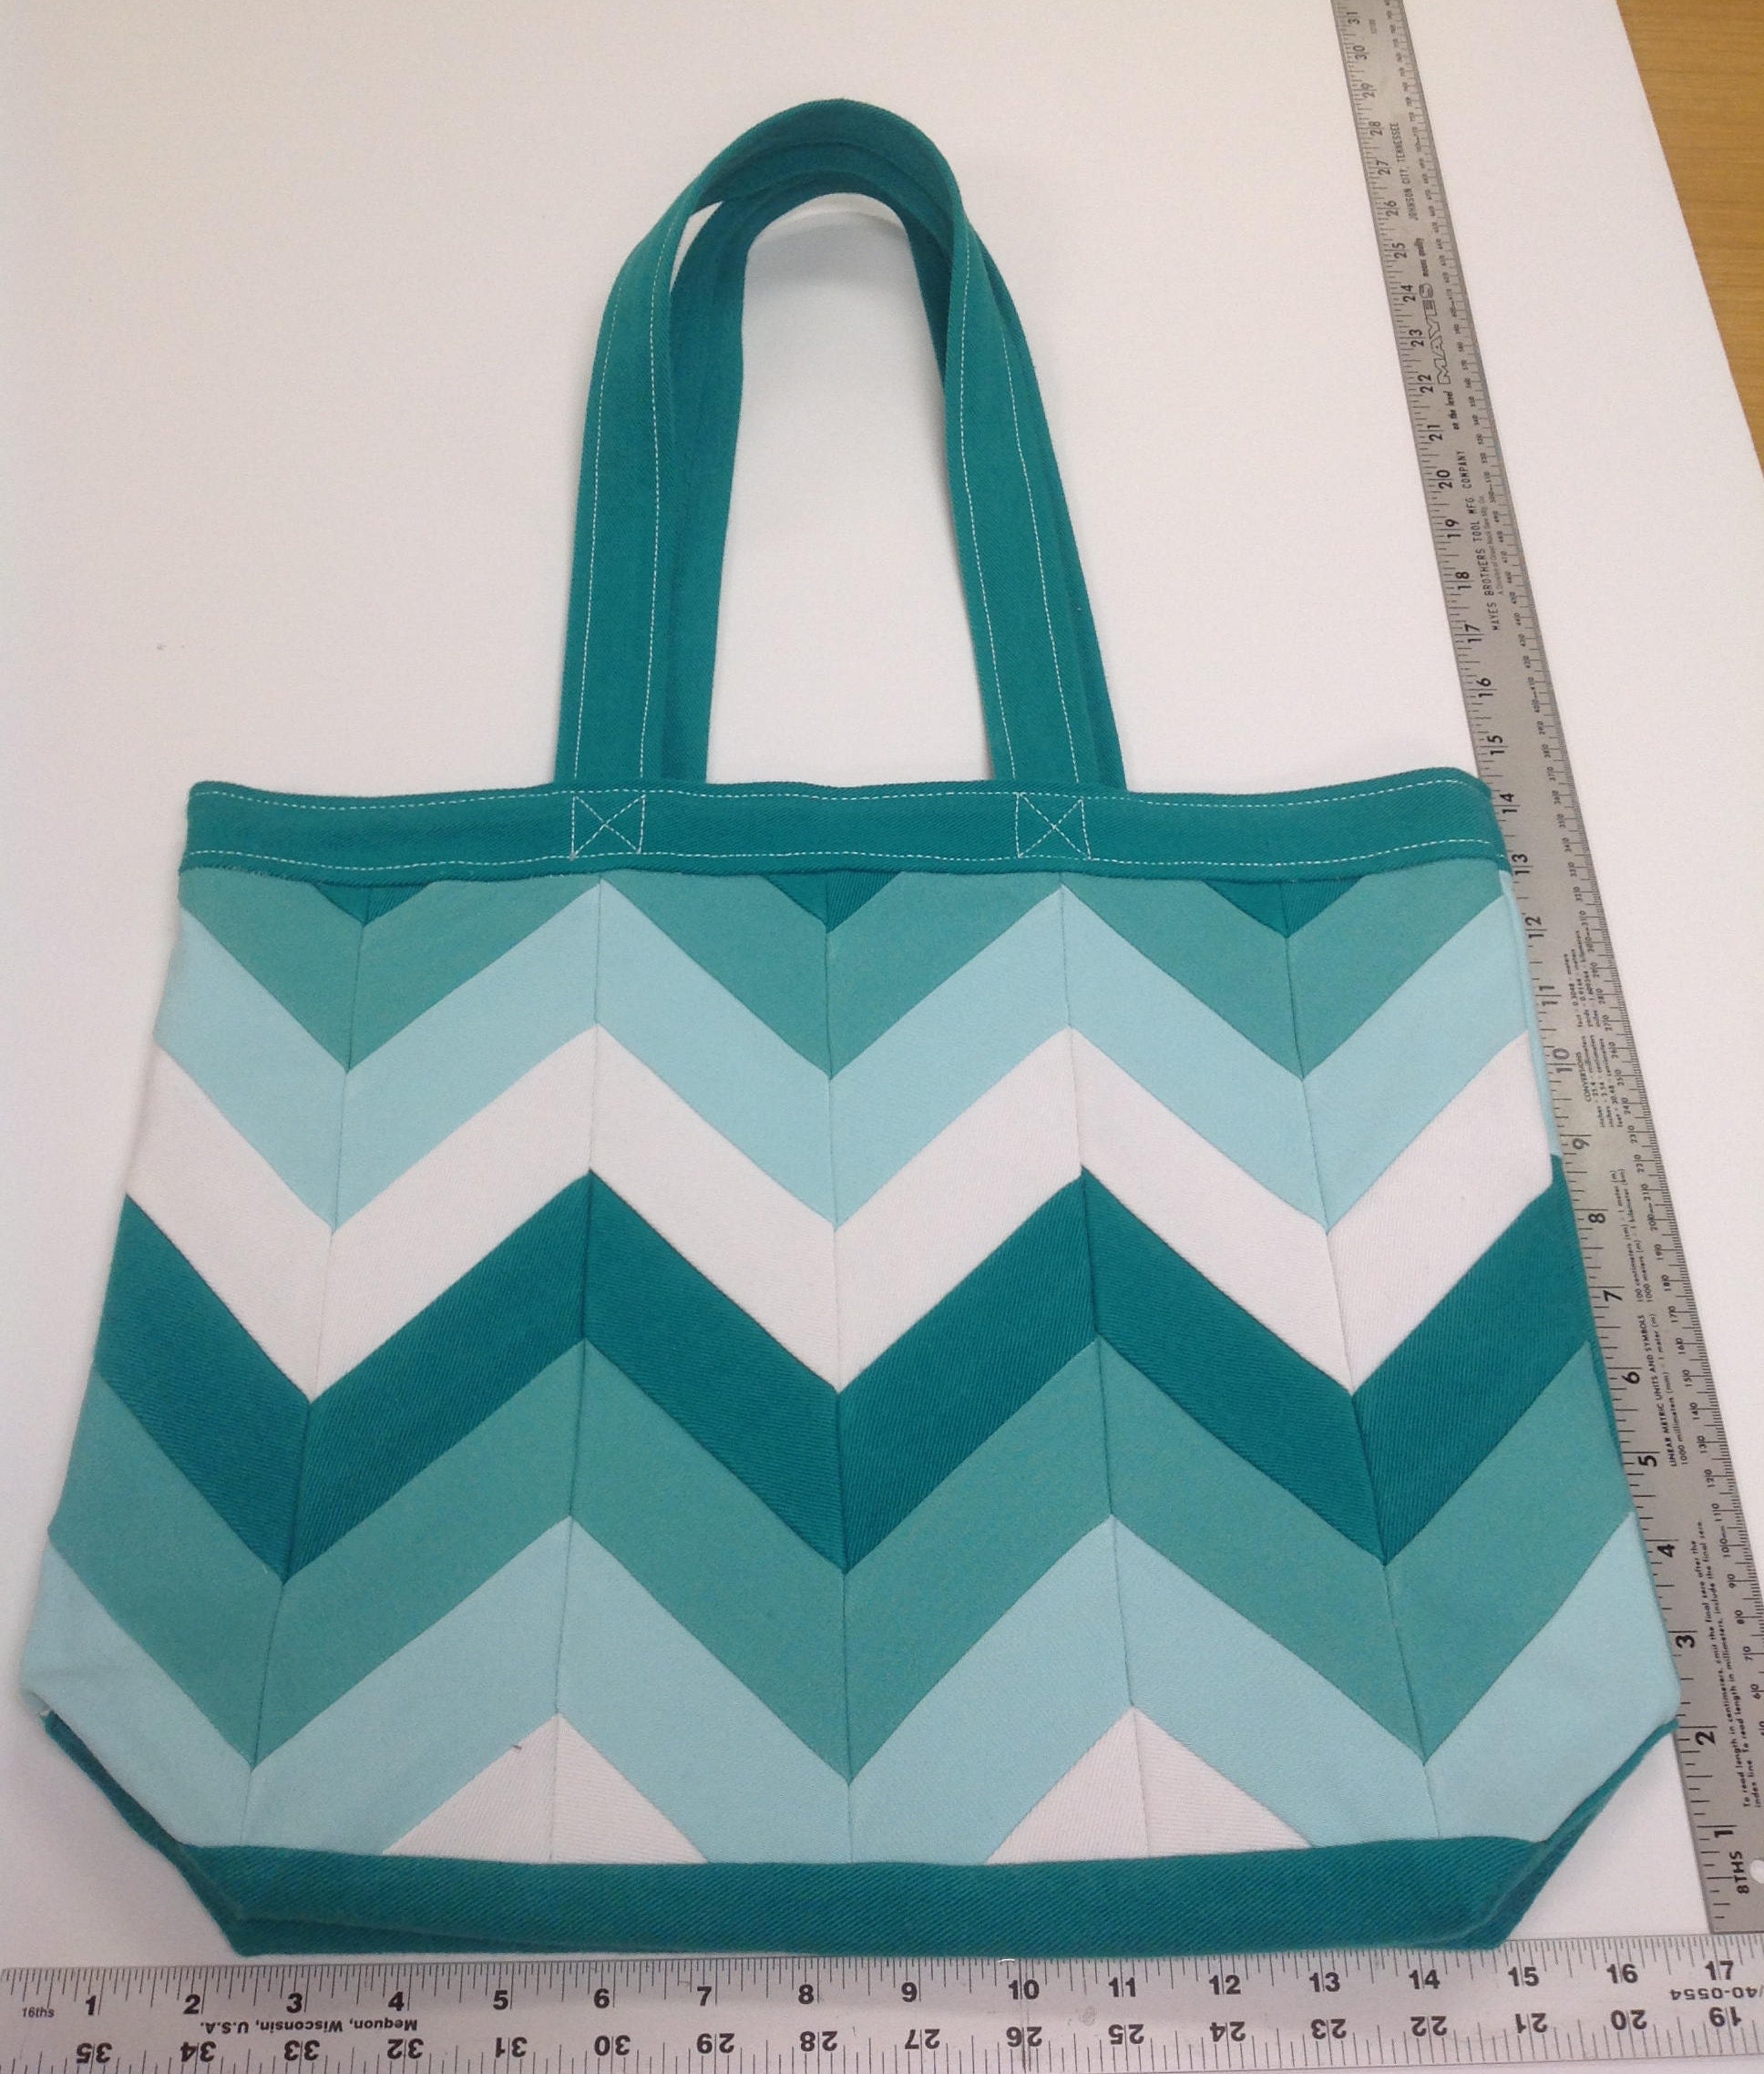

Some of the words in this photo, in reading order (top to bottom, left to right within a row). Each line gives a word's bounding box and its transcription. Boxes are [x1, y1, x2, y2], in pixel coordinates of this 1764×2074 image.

[1346, 11, 1359, 25] 31
[1352, 46, 1367, 59] 30
[1361, 82, 1375, 98] 29
[1369, 120, 1383, 137] 28
[1376, 159, 1390, 175] 27
[1384, 200, 1399, 217] 26
[1392, 242, 1407, 259] 25
[1401, 285, 1416, 302] 24
[1410, 329, 1424, 346] 23
[1418, 282, 1451, 385] MAYES
[1418, 374, 1433, 394] 22
[1428, 425, 1443, 441] 21
[1436, 469, 1452, 488] 20
[1457, 451, 1472, 488] COMPANY
[1445, 518, 1461, 539] 19
[1470, 520, 1482, 541] TOOL
[1456, 570, 1472, 590] 18
[1475, 548, 1493, 596] BROTHERS
[1487, 601, 1499, 630] MAYES
[1465, 623, 1482, 643] 17
[1476, 678, 1492, 698] 16
[1487, 734, 1505, 755] 15
[1500, 793, 1517, 814] 14
[1513, 854, 1529, 875] 13
[1525, 917, 1544, 939] 12
[1540, 985, 1558, 1004] 11
[1553, 1049, 1573, 1073] 10
[1573, 1138, 1590, 1150] 9
[1588, 1213, 1605, 1224] 8
[1604, 1290, 1622, 1301] 7
[1637, 1315, 1651, 1351] SYMBOLS
[1646, 1355, 1656, 1372] AND
[1622, 1371, 1640, 1383] 6
[1682, 1369, 1692, 1387] 150
[1651, 1376, 1662, 1400] UNITS
[1656, 1403, 1668, 1432] METRIC
[1689, 1401, 1699, 1420] 140
[1665, 1437, 1677, 1466] LINEAR
[1697, 1435, 1707, 1453] 130
[1638, 1455, 1656, 1467] 5
[1677, 1445, 1687, 1464] 1000
[1704, 1469, 1715, 1487] 120
[1711, 1504, 1722, 1522] 110
[1657, 1544, 1675, 1558] 4
[1727, 1574, 1736, 1587] 90
[1735, 1609, 1745, 1624] 80
[1676, 1635, 1695, 1648] 3
[1742, 1646, 1753, 1660] 70
[1751, 1684, 1760, 1699] 60
[1695, 1731, 1715, 1746] 2
[1730, 1739, 1742, 1768] length
[1737, 1771, 1747, 1792] read
[1715, 1830, 1735, 1839] 1
[1730, 1850, 1749, 1894] 8THS
[1409, 1969, 1441, 1990] 14
[1508, 1966, 1540, 1987] 15
[1607, 1964, 1638, 1984] 16
[1705, 1960, 1733, 1980] 17
[900, 1982, 918, 2003] 9
[1008, 1979, 1041, 1999] 10
[1108, 1976, 1137, 1997] 11
[1208, 1975, 1241, 1996] 12
[1309, 1972, 1341, 1993] 13
[184, 1994, 201, 2015] 2
[286, 1993, 303, 2014] 3
[387, 1991, 405, 2012] 4
[493, 1989, 508, 2010] 5
[593, 1988, 610, 2008] 6
[696, 1987, 713, 2007] 7
[798, 1985, 815, 2005] 8
[86, 1996, 97, 2016] 1
[255, 2019, 343, 2034] Wisconsin,
[350, 2018, 417, 2032] Mequon,
[1410, 2016, 1447, 2037] 22
[1514, 2012, 1547, 2034] 21
[1611, 2009, 1647, 2030] 20
[1708, 2007, 1742, 2027] 19
[904, 2028, 940, 2049] 27
[1006, 2026, 1042, 2047] 26
[1108, 2023, 1144, 2045] 25
[1210, 2021, 1246, 2042] 24
[1310, 2018, 1347, 2039] 23
[284, 2039, 321, 2061] 33
[387, 2038, 425, 2059] 32
[495, 2036, 528, 2058] 31
[594, 2035, 631, 2056] 30
[696, 2032, 735, 2054] 29
[800, 2030, 838, 2052] 28
[76, 2043, 113, 2064] 35
[180, 2041, 217, 2063] 34
